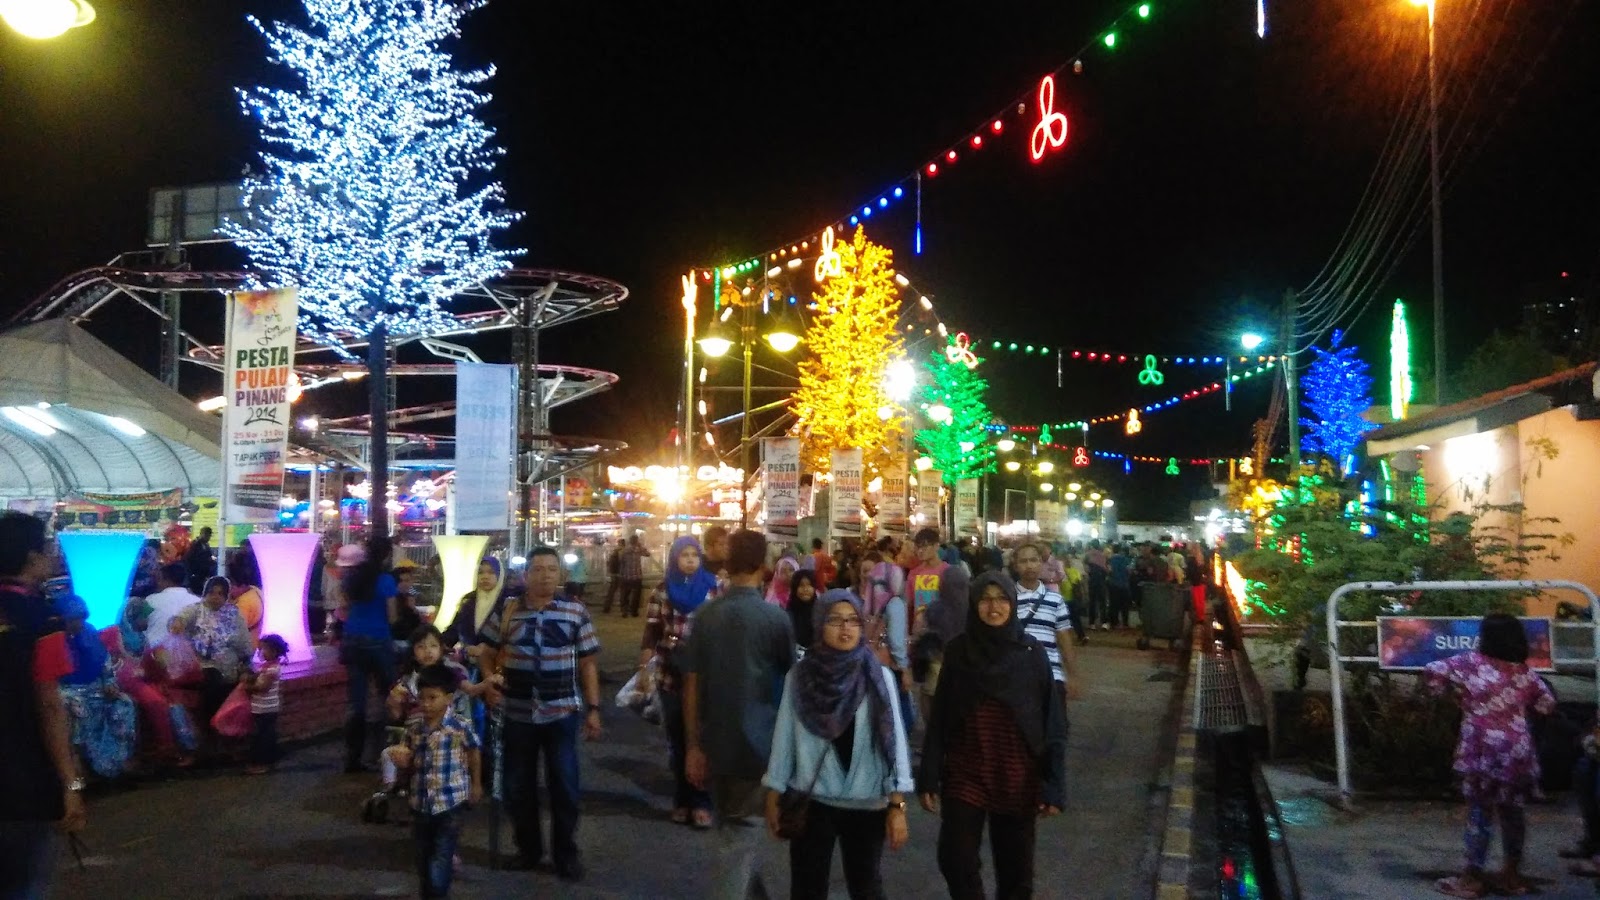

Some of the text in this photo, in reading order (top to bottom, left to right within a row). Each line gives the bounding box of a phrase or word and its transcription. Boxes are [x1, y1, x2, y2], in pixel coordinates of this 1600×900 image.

[236, 346, 289, 368] PESTA
[235, 367, 289, 389] PULAU
[235, 387, 287, 407] PINANG
[244, 406, 283, 426] 2014
[767, 463, 796, 473] PESTA
[835, 469, 860, 478] PESTA
[767, 481, 797, 490] PINANG
[1435, 635, 1481, 650] SURA
